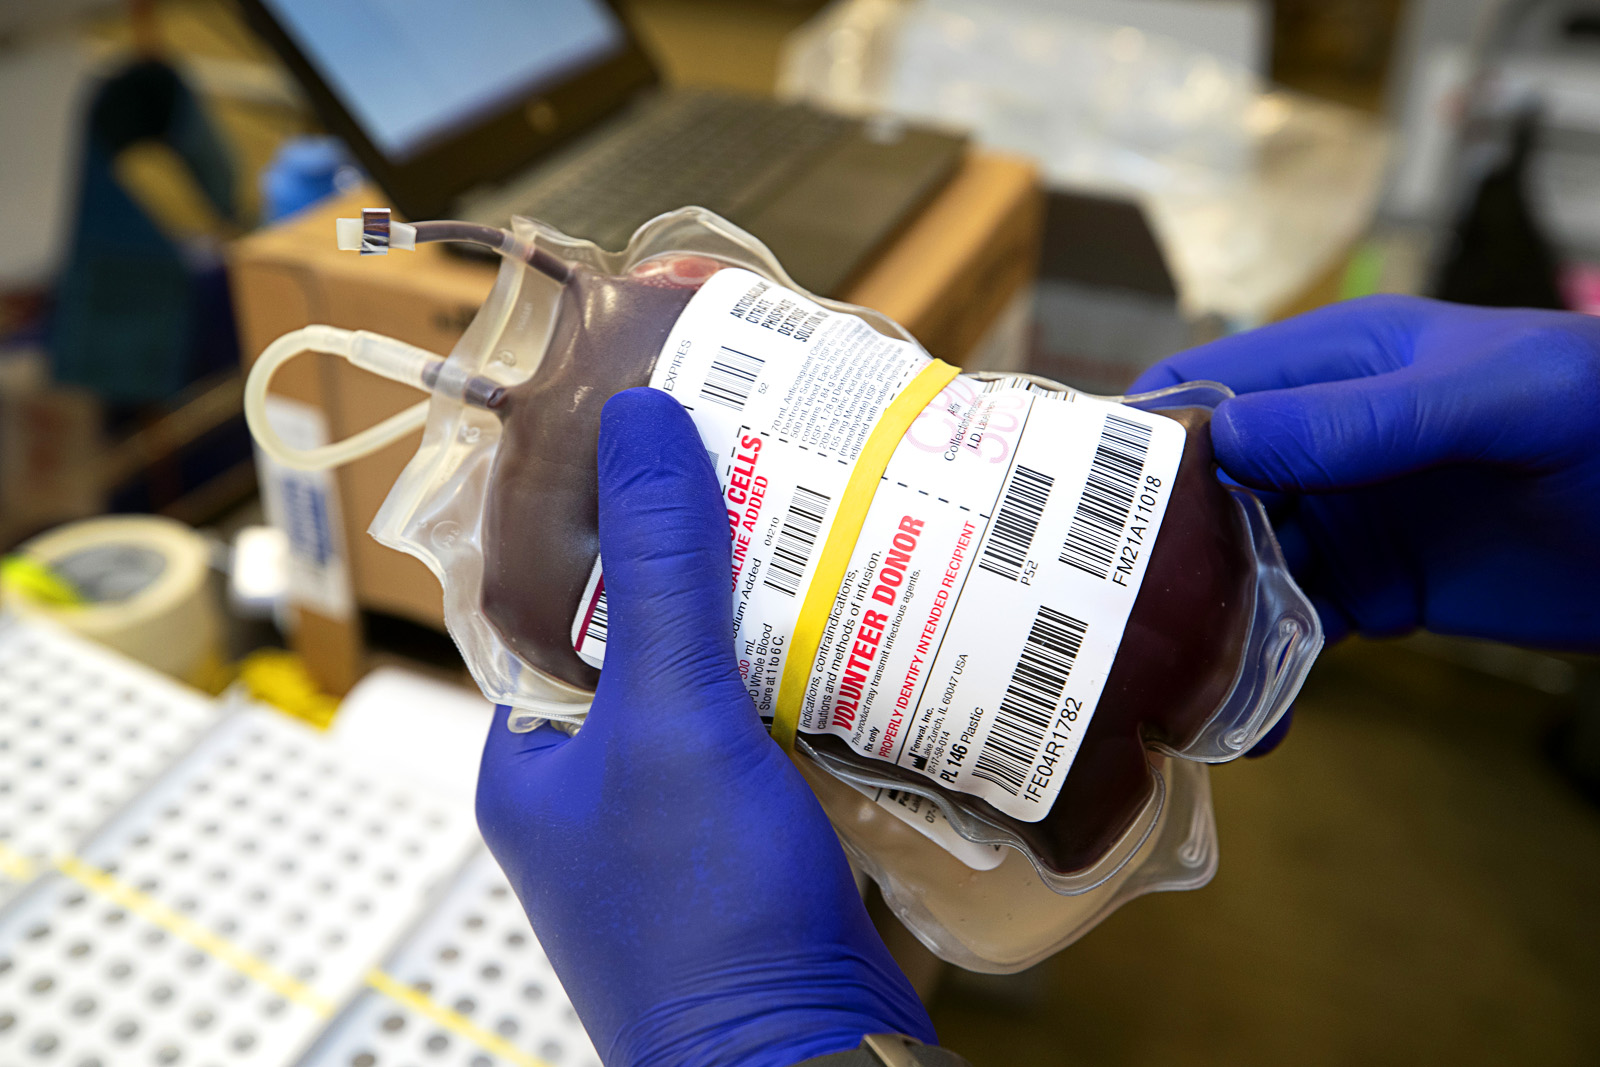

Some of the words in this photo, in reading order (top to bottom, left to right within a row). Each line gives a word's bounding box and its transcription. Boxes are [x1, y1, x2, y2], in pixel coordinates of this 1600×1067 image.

[745, 299, 773, 324] CITRATE
[663, 340, 691, 392] EXPIRES
[865, 359, 882, 380] Sodium
[758, 382, 768, 394] 52
[771, 419, 781, 431] 70
[778, 407, 788, 419] mL
[784, 355, 814, 405] Anticoagulant
[780, 396, 803, 435] Dextrose
[817, 346, 830, 361] USP
[790, 421, 803, 439] 500
[799, 409, 810, 421] mL
[817, 365, 832, 382] Each
[801, 406, 821, 442] contains
[817, 388, 830, 403] 1.84
[829, 357, 848, 381] Sodium
[820, 403, 834, 420] 1.78
[833, 366, 854, 396] Dextrose
[843, 380, 869, 419] Monobasic
[819, 432, 831, 449] 209
[828, 418, 840, 432] mg
[834, 396, 849, 417] Citric
[845, 379, 858, 396] Acid
[838, 420, 850, 434] mg
[838, 400, 871, 457] (monohydrate)
[849, 422, 870, 460] adjusted
[866, 406, 878, 422] with
[875, 381, 891, 405] sodium
[829, 436, 841, 451] 155
[967, 433, 983, 450] I.D.
[727, 435, 762, 505] CELLS
[742, 475, 768, 533] ADDED
[764, 517, 779, 546] 04210
[1112, 475, 1162, 587] FM21A11018
[741, 558, 762, 600] Added
[853, 551, 881, 601] infusion.
[903, 569, 921, 604] agents.
[1020, 560, 1038, 586] P52
[831, 609, 889, 732] VOLUNTEER
[871, 515, 925, 606] DONOR
[850, 602, 861, 617] of
[756, 623, 772, 656] Blood
[772, 635, 784, 646] C.
[831, 619, 855, 671] methods
[877, 709, 904, 760] PROPERLY
[895, 655, 924, 710] IDENTIFY
[916, 590, 949, 655] INTENDED
[941, 520, 975, 588] RECIPIENT
[883, 605, 907, 650] infectious
[744, 640, 756, 656] mL
[768, 656, 780, 666] to
[799, 676, 822, 730] indications,
[815, 570, 859, 673] contraindications,
[952, 654, 968, 675] USA
[750, 657, 765, 690] Whole
[766, 677, 776, 686] at
[825, 671, 837, 694] and
[870, 650, 890, 687] transmit
[760, 687, 774, 712] Store
[865, 688, 878, 706] may
[942, 676, 958, 705] 60047
[815, 695, 832, 730] cautions
[857, 704, 871, 734] product
[911, 726, 928, 752] Fenwal,
[921, 708, 934, 723] Inc.
[960, 707, 984, 745] Plastic
[868, 726, 880, 743] only
[926, 717, 946, 744] Zurich,
[923, 743, 934, 760] Lake
[926, 731, 951, 776] 07-17-58-014
[946, 743, 968, 768] 146
[1023, 697, 1083, 803] 1FE04R1782
[939, 769, 959, 784] PL
